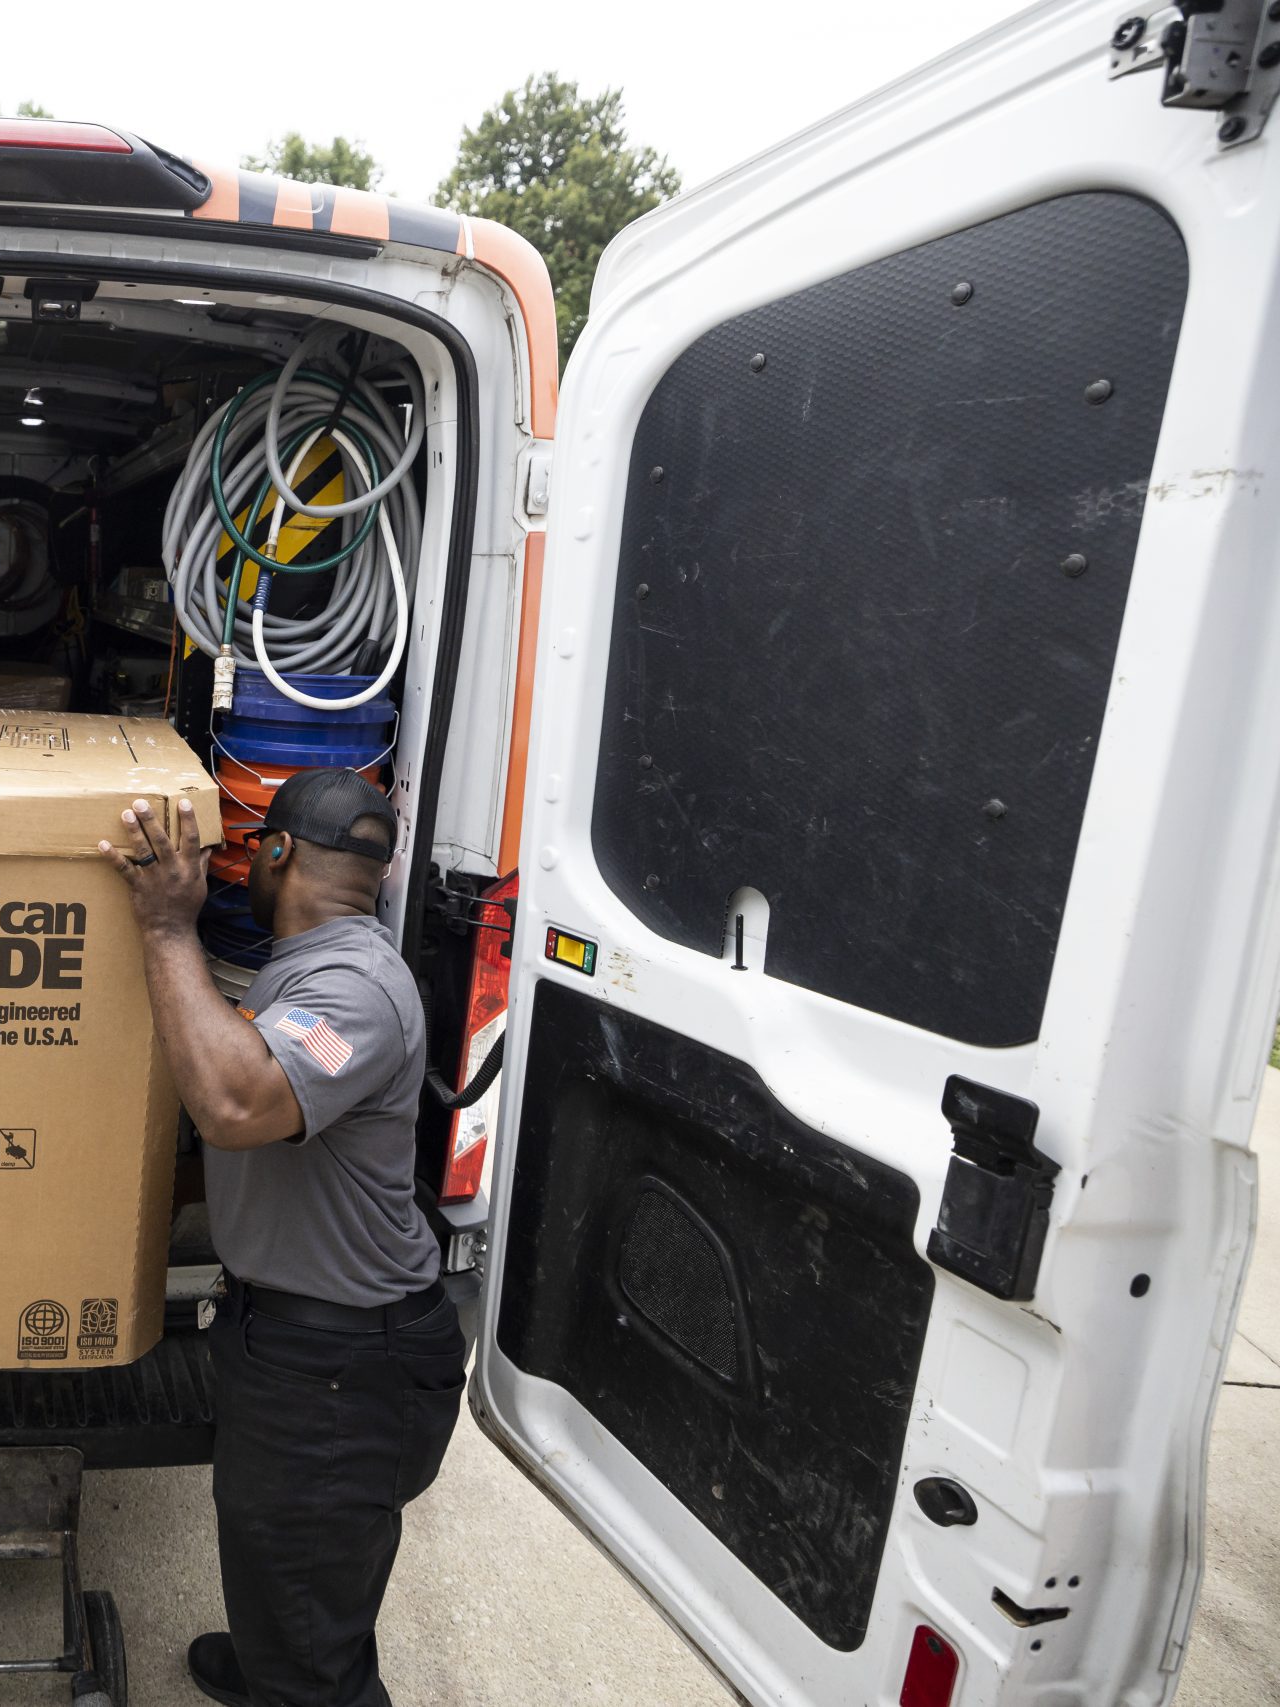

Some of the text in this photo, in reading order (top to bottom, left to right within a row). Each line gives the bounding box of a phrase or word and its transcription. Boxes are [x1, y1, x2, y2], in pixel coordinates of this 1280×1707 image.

[23, 1028, 78, 1046] U.S.A.
[21, 1336, 65, 1345] ISO 9001
[80, 1337, 92, 1346] ISO
